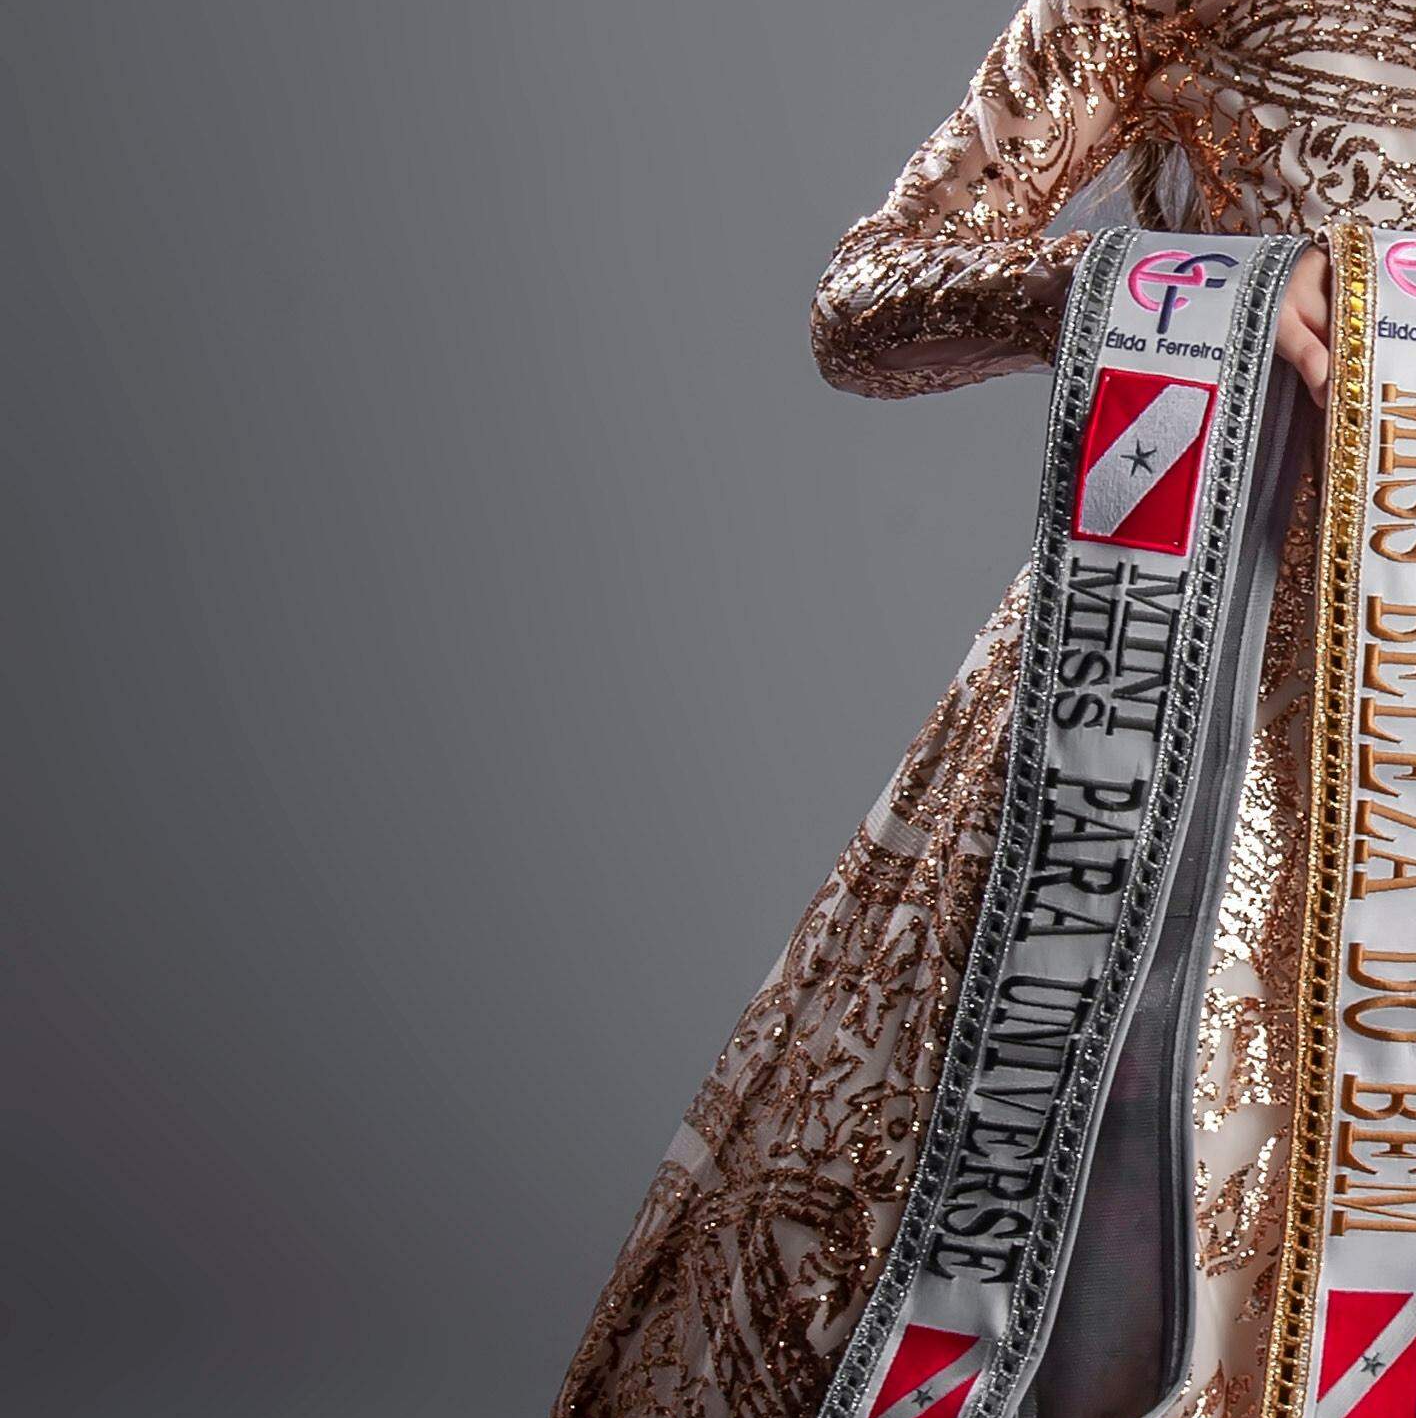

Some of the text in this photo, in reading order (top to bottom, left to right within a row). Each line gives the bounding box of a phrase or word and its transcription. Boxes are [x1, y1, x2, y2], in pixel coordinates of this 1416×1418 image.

[1105, 326, 1225, 361] Élida Ferreira
[1052, 557, 1125, 730] MISS
[1105, 564, 1188, 742] MINI
[925, 768, 1146, 1284] PARA UNIVERSE
